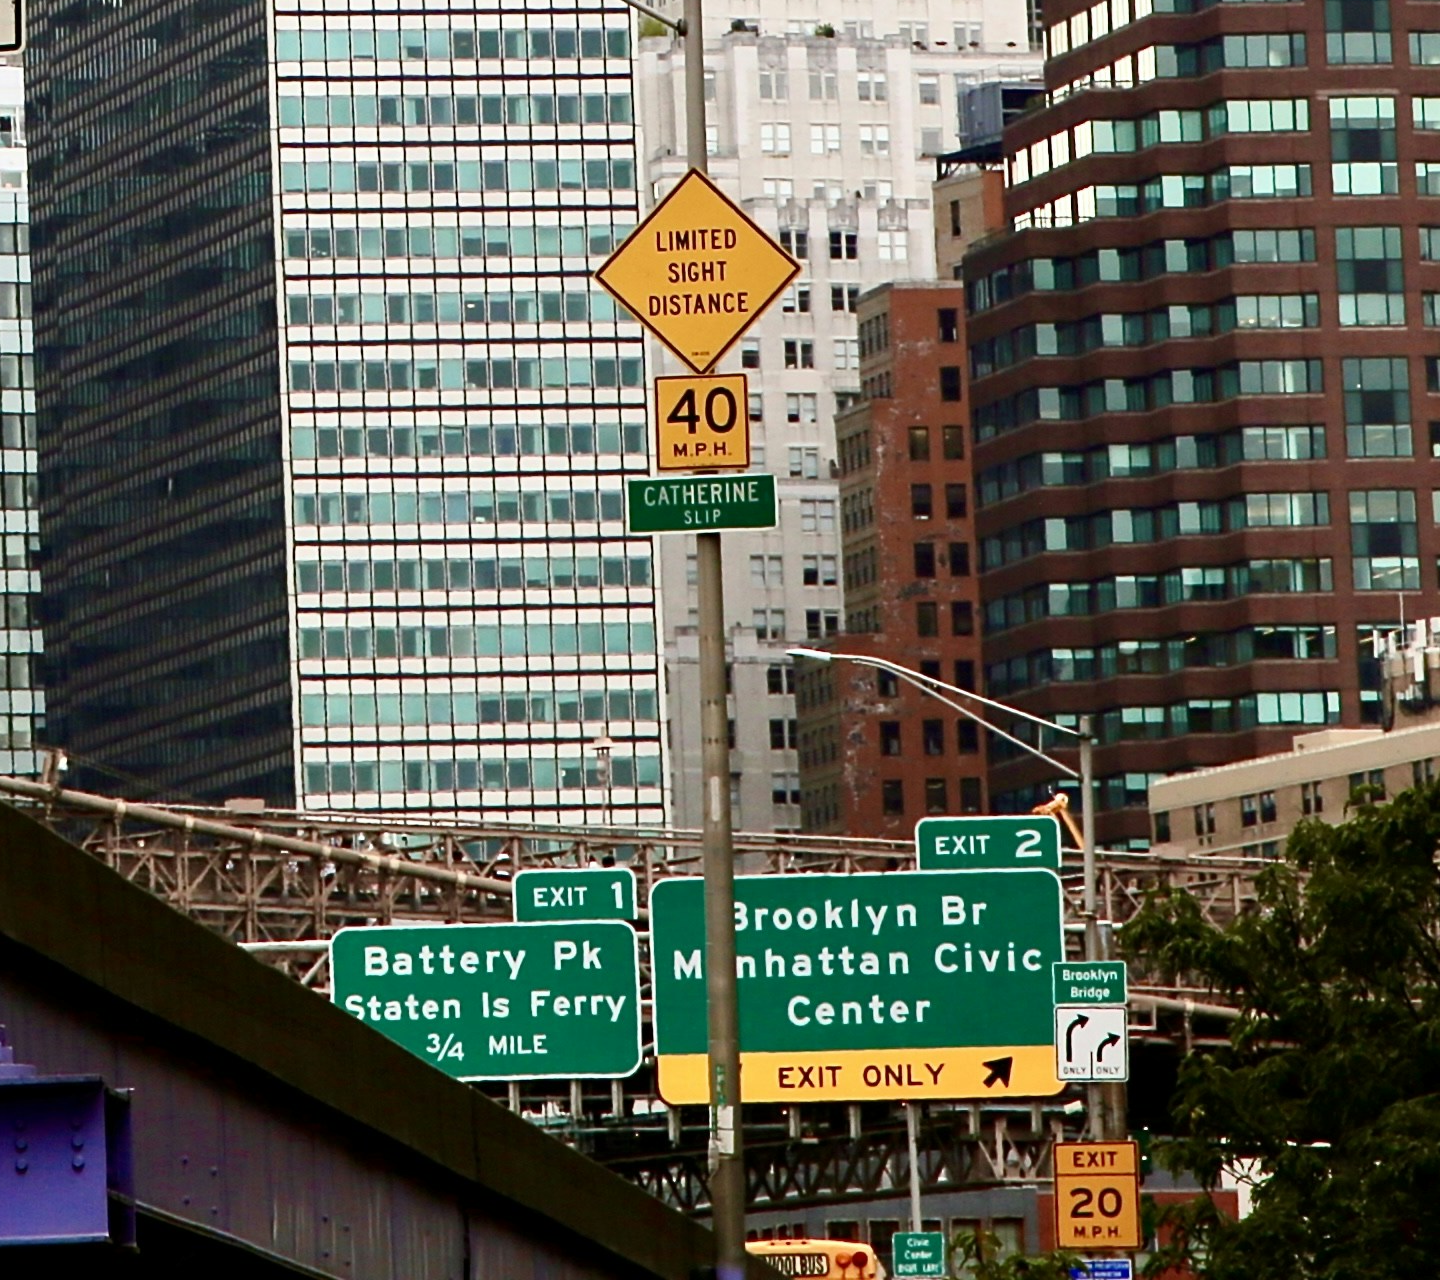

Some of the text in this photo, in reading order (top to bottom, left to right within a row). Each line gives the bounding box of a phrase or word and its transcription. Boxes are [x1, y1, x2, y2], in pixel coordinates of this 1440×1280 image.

[656, 228, 737, 252] LIMITED
[667, 260, 728, 284] SIGHT
[648, 291, 750, 317] DISTANCE
[666, 386, 739, 435] 40
[673, 441, 732, 458] M.P.H.
[643, 480, 760, 507] CATHERINE
[684, 508, 722, 526] SLIP
[935, 829, 1044, 858] EXIT 2
[533, 881, 624, 910] EXIT 1
[941, 895, 988, 926] Br
[364, 940, 603, 981] Battery Pk
[672, 941, 1043, 981] Mnhattan Civic
[1062, 968, 1118, 983] Brooklyn
[345, 990, 627, 1023] Staten Is Ferry
[1070, 986, 1111, 1001] Bridge
[787, 994, 932, 1028] Center
[488, 1034, 549, 1057] MILE
[778, 1063, 946, 1090] EXIT ONLY
[1063, 1066, 1086, 1075] ONLY
[1095, 1066, 1120, 1075] ONLY
[1072, 1150, 1118, 1168] EXIT
[1069, 1187, 1123, 1219] 20
